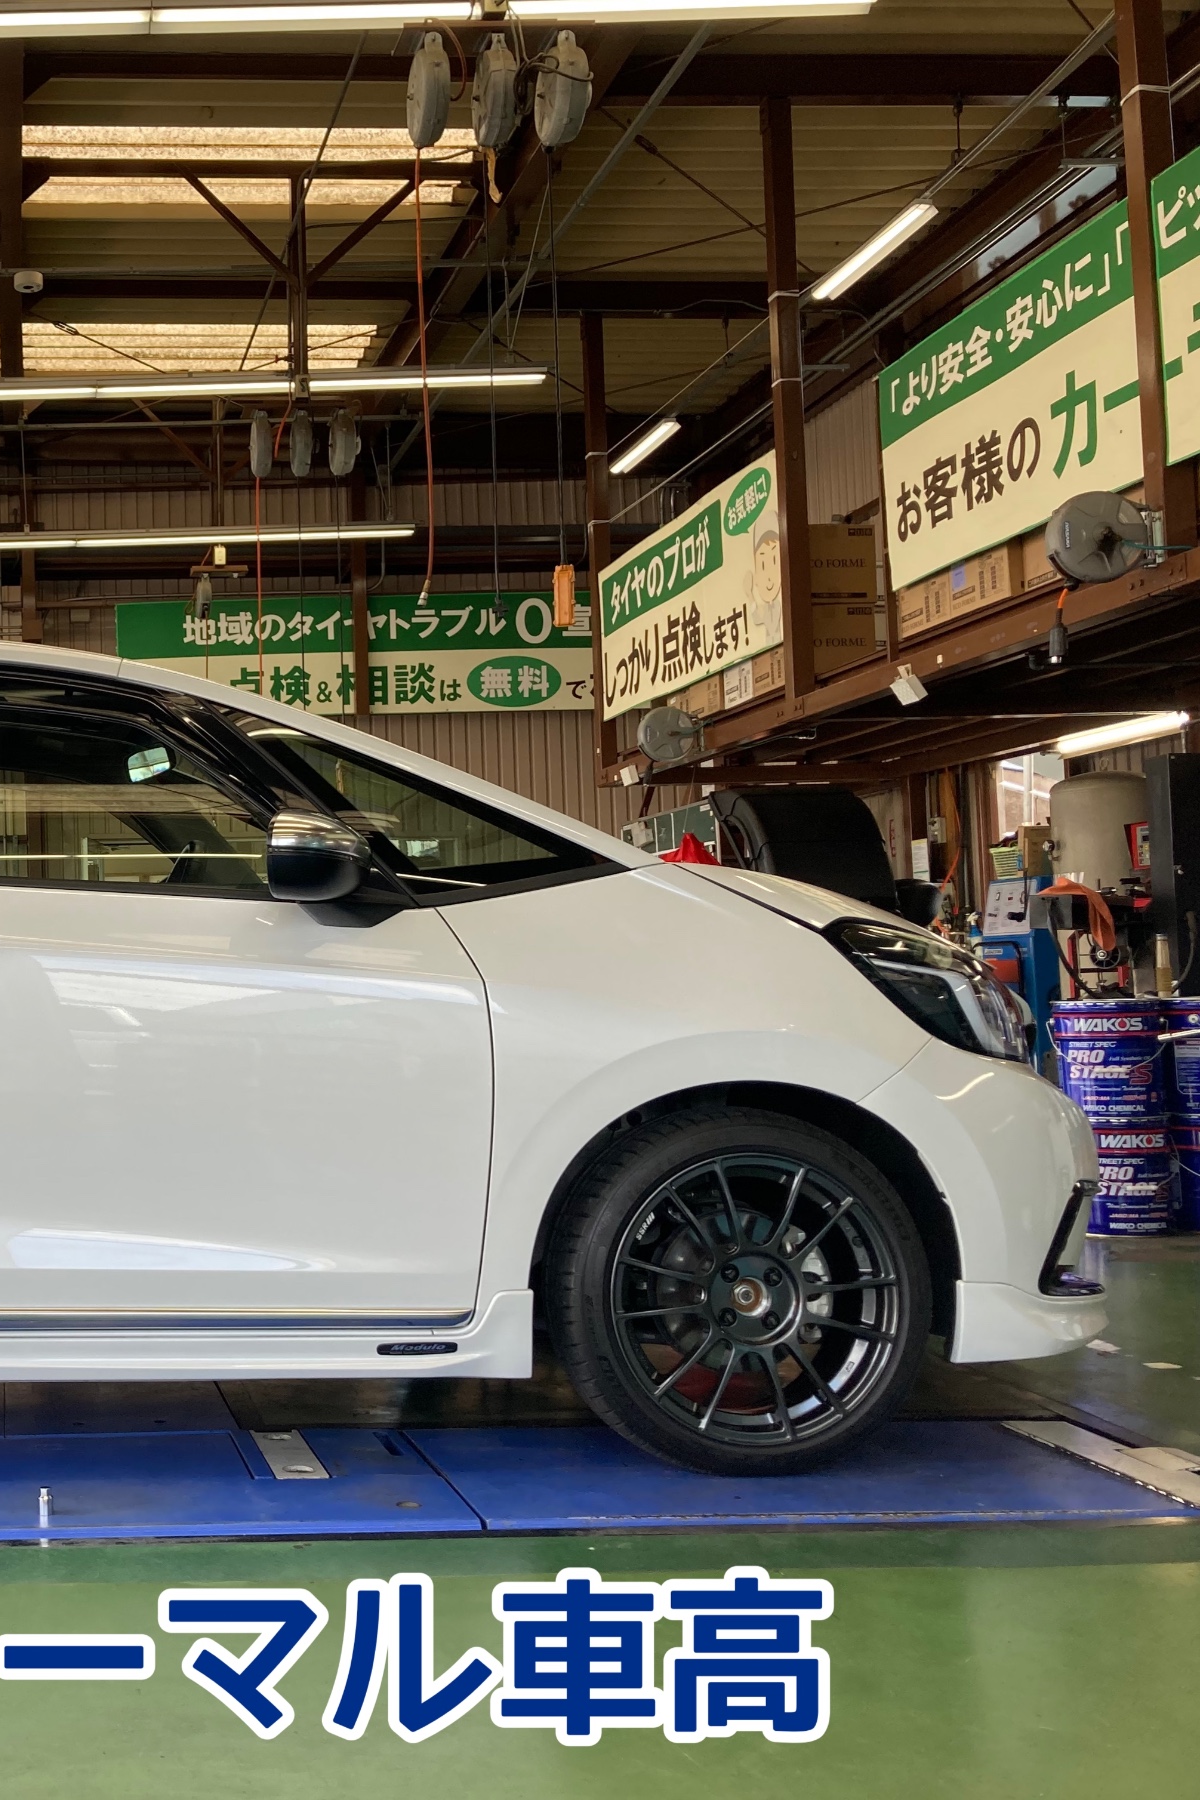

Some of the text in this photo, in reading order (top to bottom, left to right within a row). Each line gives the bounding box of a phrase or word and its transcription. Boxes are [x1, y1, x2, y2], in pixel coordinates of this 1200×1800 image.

[727, 473, 768, 530] お気軽に!
[610, 514, 711, 625] タイヤのプロが
[826, 558, 866, 568] FORME
[826, 638, 867, 647] FORME
[604, 601, 750, 708] しっかり点検します!
[1074, 1017, 1143, 1031] WAKO'S
[1067, 1049, 1105, 1063] PRO
[1070, 1065, 1131, 1079] STAGE
[1101, 1134, 1164, 1148] WAKO'S
[390, 1343, 446, 1351] Modulo
